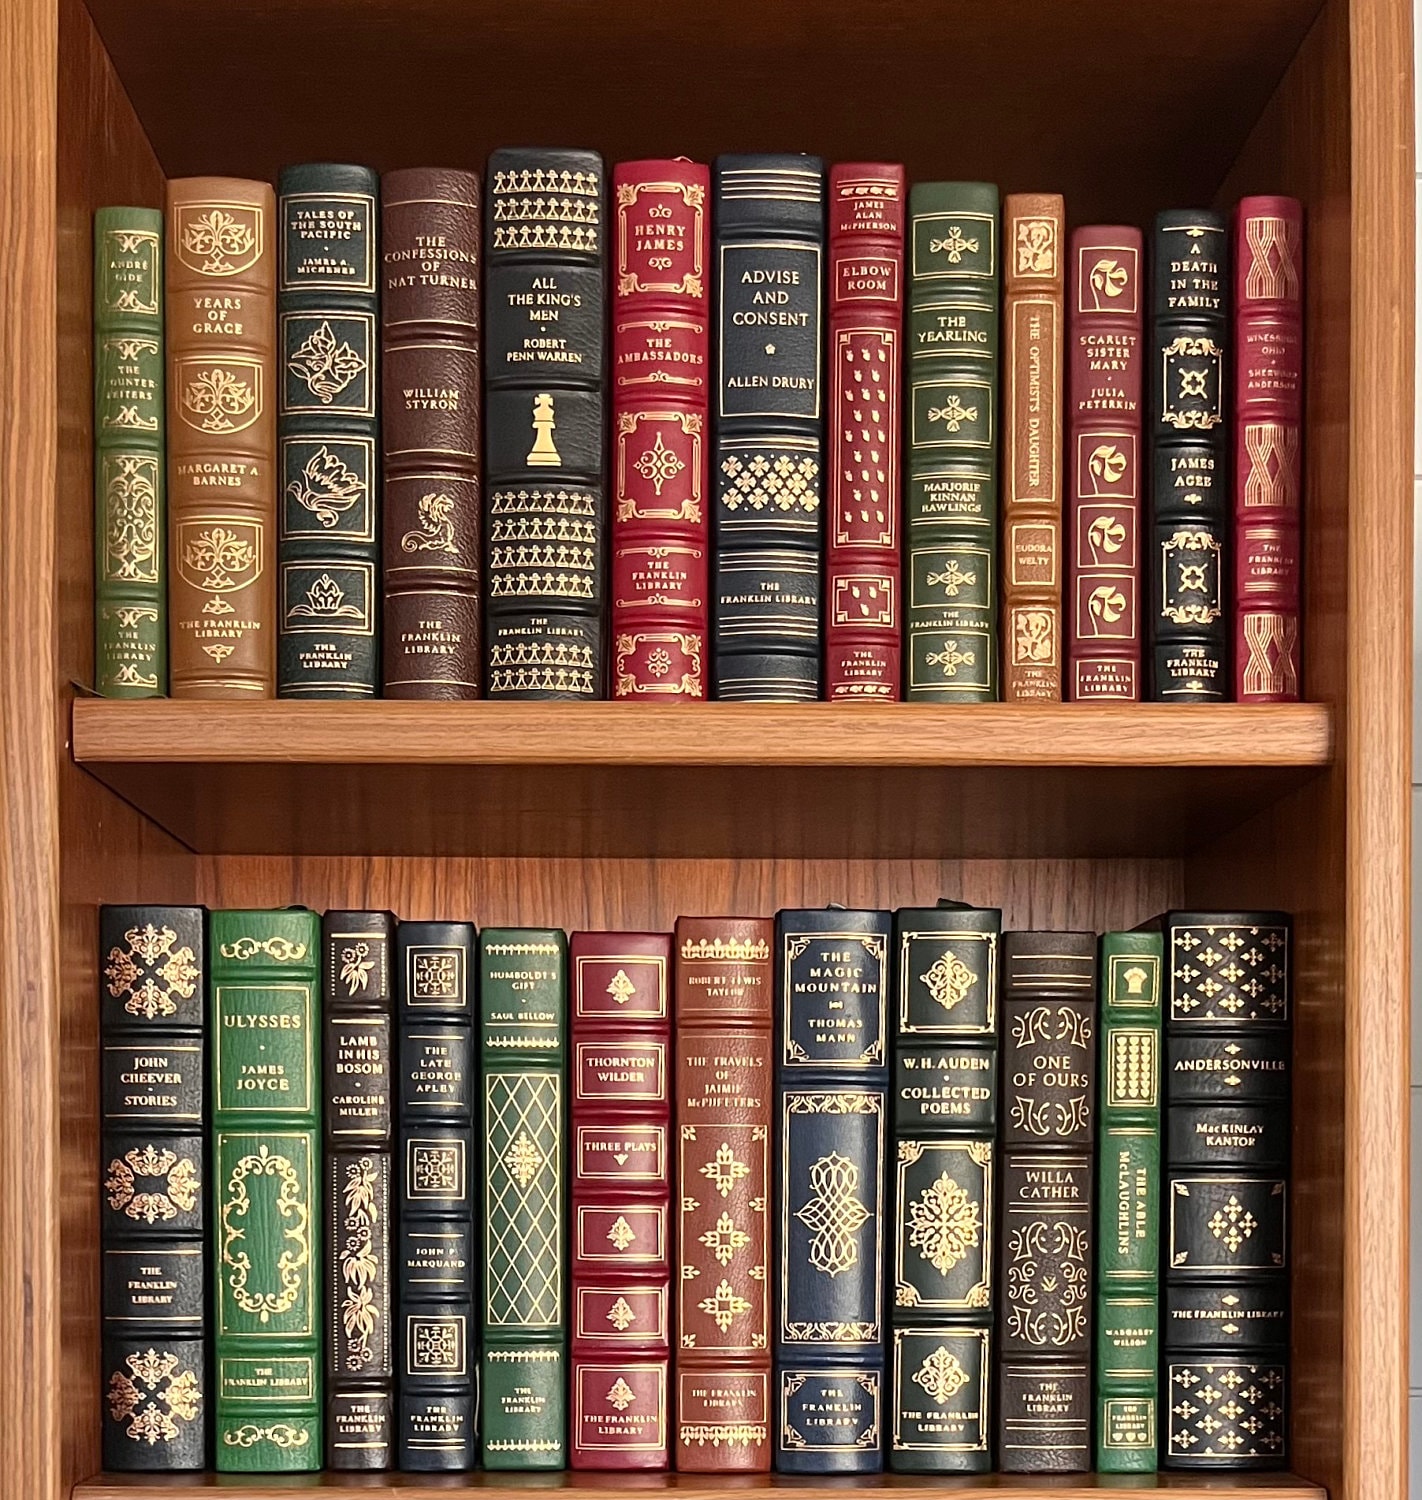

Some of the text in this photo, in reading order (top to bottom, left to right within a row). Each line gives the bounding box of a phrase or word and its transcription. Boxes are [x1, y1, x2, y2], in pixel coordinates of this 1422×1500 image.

[297, 210, 354, 220] TALES OF
[291, 221, 361, 231] THE SOUTH
[635, 224, 685, 237] HENRY
[301, 230, 351, 239] PACIFIC
[416, 236, 446, 247] THE
[637, 239, 684, 251] JAMES
[1190, 243, 1200, 254] A
[384, 249, 476, 265] CONFESSIONS
[422, 261, 440, 271] OF
[843, 266, 891, 276] ELBOW
[1171, 261, 1217, 273] DEATH
[389, 275, 477, 290] NAT TURNER
[741, 270, 799, 284] ADVISE
[532, 277, 557, 289] ALL
[848, 280, 886, 290] ROOM
[1171, 278, 1218, 290] IN THE
[195, 297, 241, 309] YEARS
[508, 293, 581, 307] THE KING'S
[753, 291, 789, 304] AND
[1168, 296, 1220, 308] FAMILY
[208, 310, 227, 321] OF
[530, 310, 558, 321] MEN
[733, 312, 809, 326] CONSENT
[937, 316, 966, 327] THE
[193, 323, 243, 335] GRACE
[1030, 317, 1040, 340] THE
[918, 330, 987, 342] YEARLING
[1080, 335, 1136, 346] SCARLET
[524, 338, 567, 349] ROBERT
[647, 338, 672, 348] THE
[507, 352, 582, 363] PENN WARREN
[617, 351, 703, 365] AMBASSADORS
[1087, 347, 1130, 358] SISTER
[1090, 360, 1127, 370] MARY
[728, 376, 814, 389] ALLEN DRURY
[403, 388, 460, 400] WILLIAM
[1091, 388, 1125, 398] JULIA
[406, 399, 458, 411] STYRON
[1079, 400, 1136, 411] PETERKIN
[1029, 418, 1040, 486] DAUGHTER
[1171, 458, 1214, 471] JAMES
[194, 476, 241, 486] BARNES
[1174, 475, 1211, 487] AGEE
[924, 482, 980, 492] MARJORIE
[930, 493, 976, 502] KINNAN
[922, 503, 981, 512] RAWLINGS
[648, 561, 669, 569] THE
[633, 571, 687, 580] FRANKLIN
[636, 582, 682, 590] LIBRARY
[821, 952, 851, 963] THE
[810, 967, 862, 978] MAGIC
[795, 983, 877, 993] MOUNTAIN
[224, 1014, 301, 1029] ULYSSES
[518, 1012, 555, 1020] BELLOW
[808, 1019, 863, 1028] THOMAS
[340, 1036, 378, 1046] LAMB
[816, 1032, 856, 1043] MANN
[339, 1049, 379, 1060] IN HIS
[134, 1057, 168, 1070] JOHN
[587, 1057, 654, 1068] THORNTON
[938, 1057, 989, 1070] AUDEN
[1034, 1056, 1070, 1069] ONE
[1174, 1059, 1285, 1070] ANDERSONVILLE
[242, 1065, 284, 1075] JAMES
[337, 1063, 383, 1074] BOSOM
[121, 1073, 182, 1083] CHEEVER
[598, 1071, 645, 1083] WILDER
[1013, 1073, 1088, 1087] OF OURS
[237, 1078, 290, 1091] JOYCE
[901, 1086, 990, 1099] COLLECTED
[125, 1096, 177, 1107] STORIES
[921, 1102, 971, 1114] POEMS
[1196, 1123, 1262, 1133] MacKINLAY
[585, 1142, 656, 1151] THREE PLAYS
[1206, 1136, 1255, 1146] KANTOR
[1026, 1171, 1073, 1183] WILLA
[1020, 1186, 1079, 1198] CATHER
[1118, 1151, 1130, 1254] McLAUGHLINS
[1136, 1168, 1146, 1238] THE ABLE
